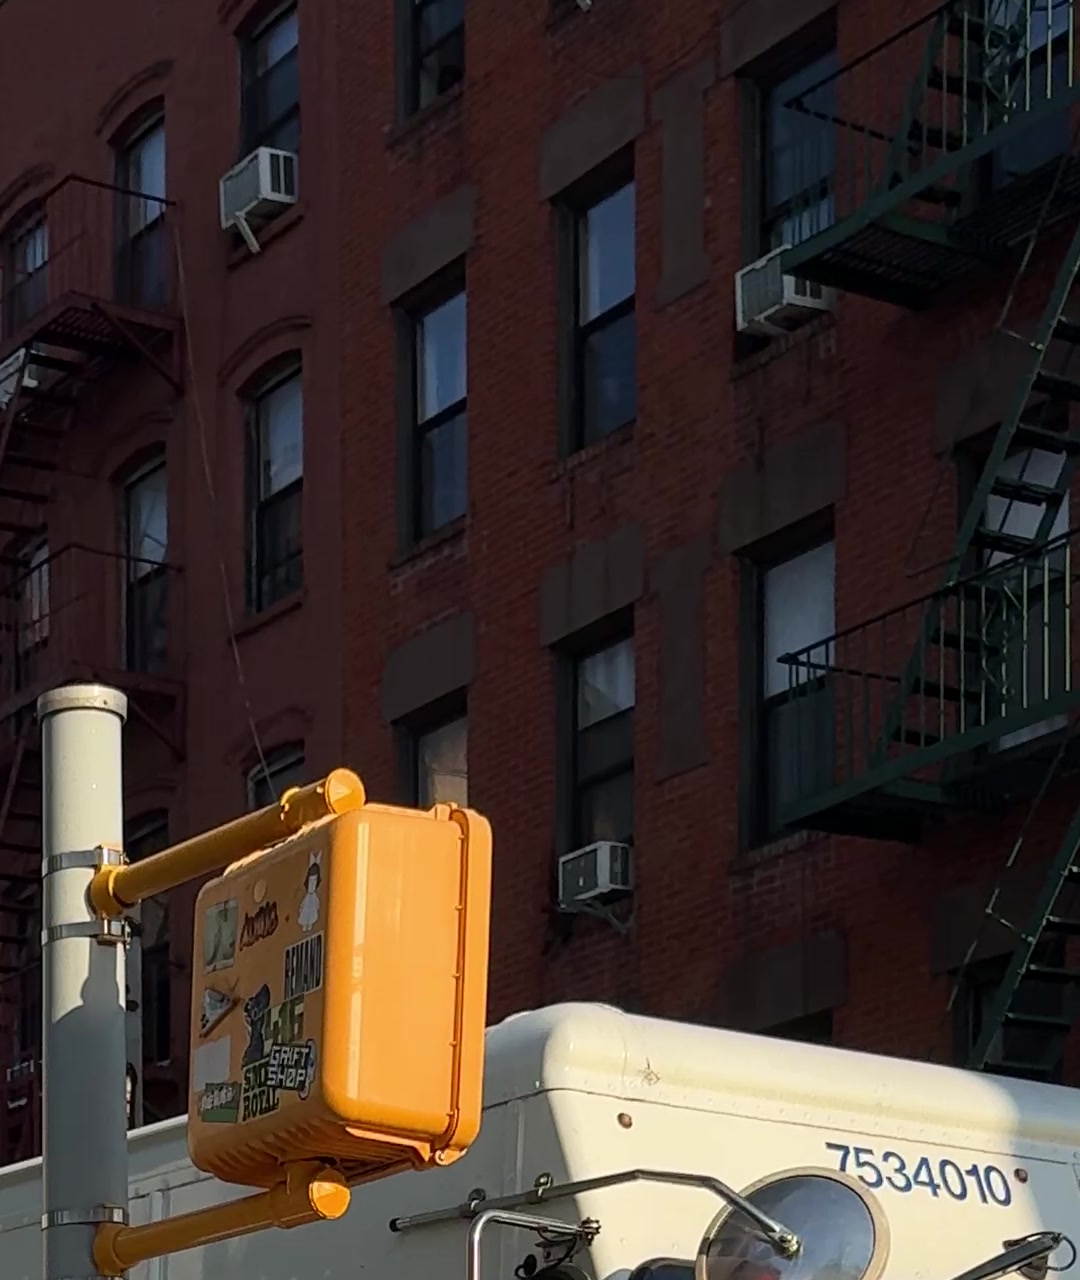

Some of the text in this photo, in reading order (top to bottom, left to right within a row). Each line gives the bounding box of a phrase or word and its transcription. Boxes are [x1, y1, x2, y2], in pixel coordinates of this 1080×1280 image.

[270, 1045, 310, 1066] GRIFT
[242, 1087, 280, 1122] ROYAL
[825, 1142, 1012, 1207] 7534010
